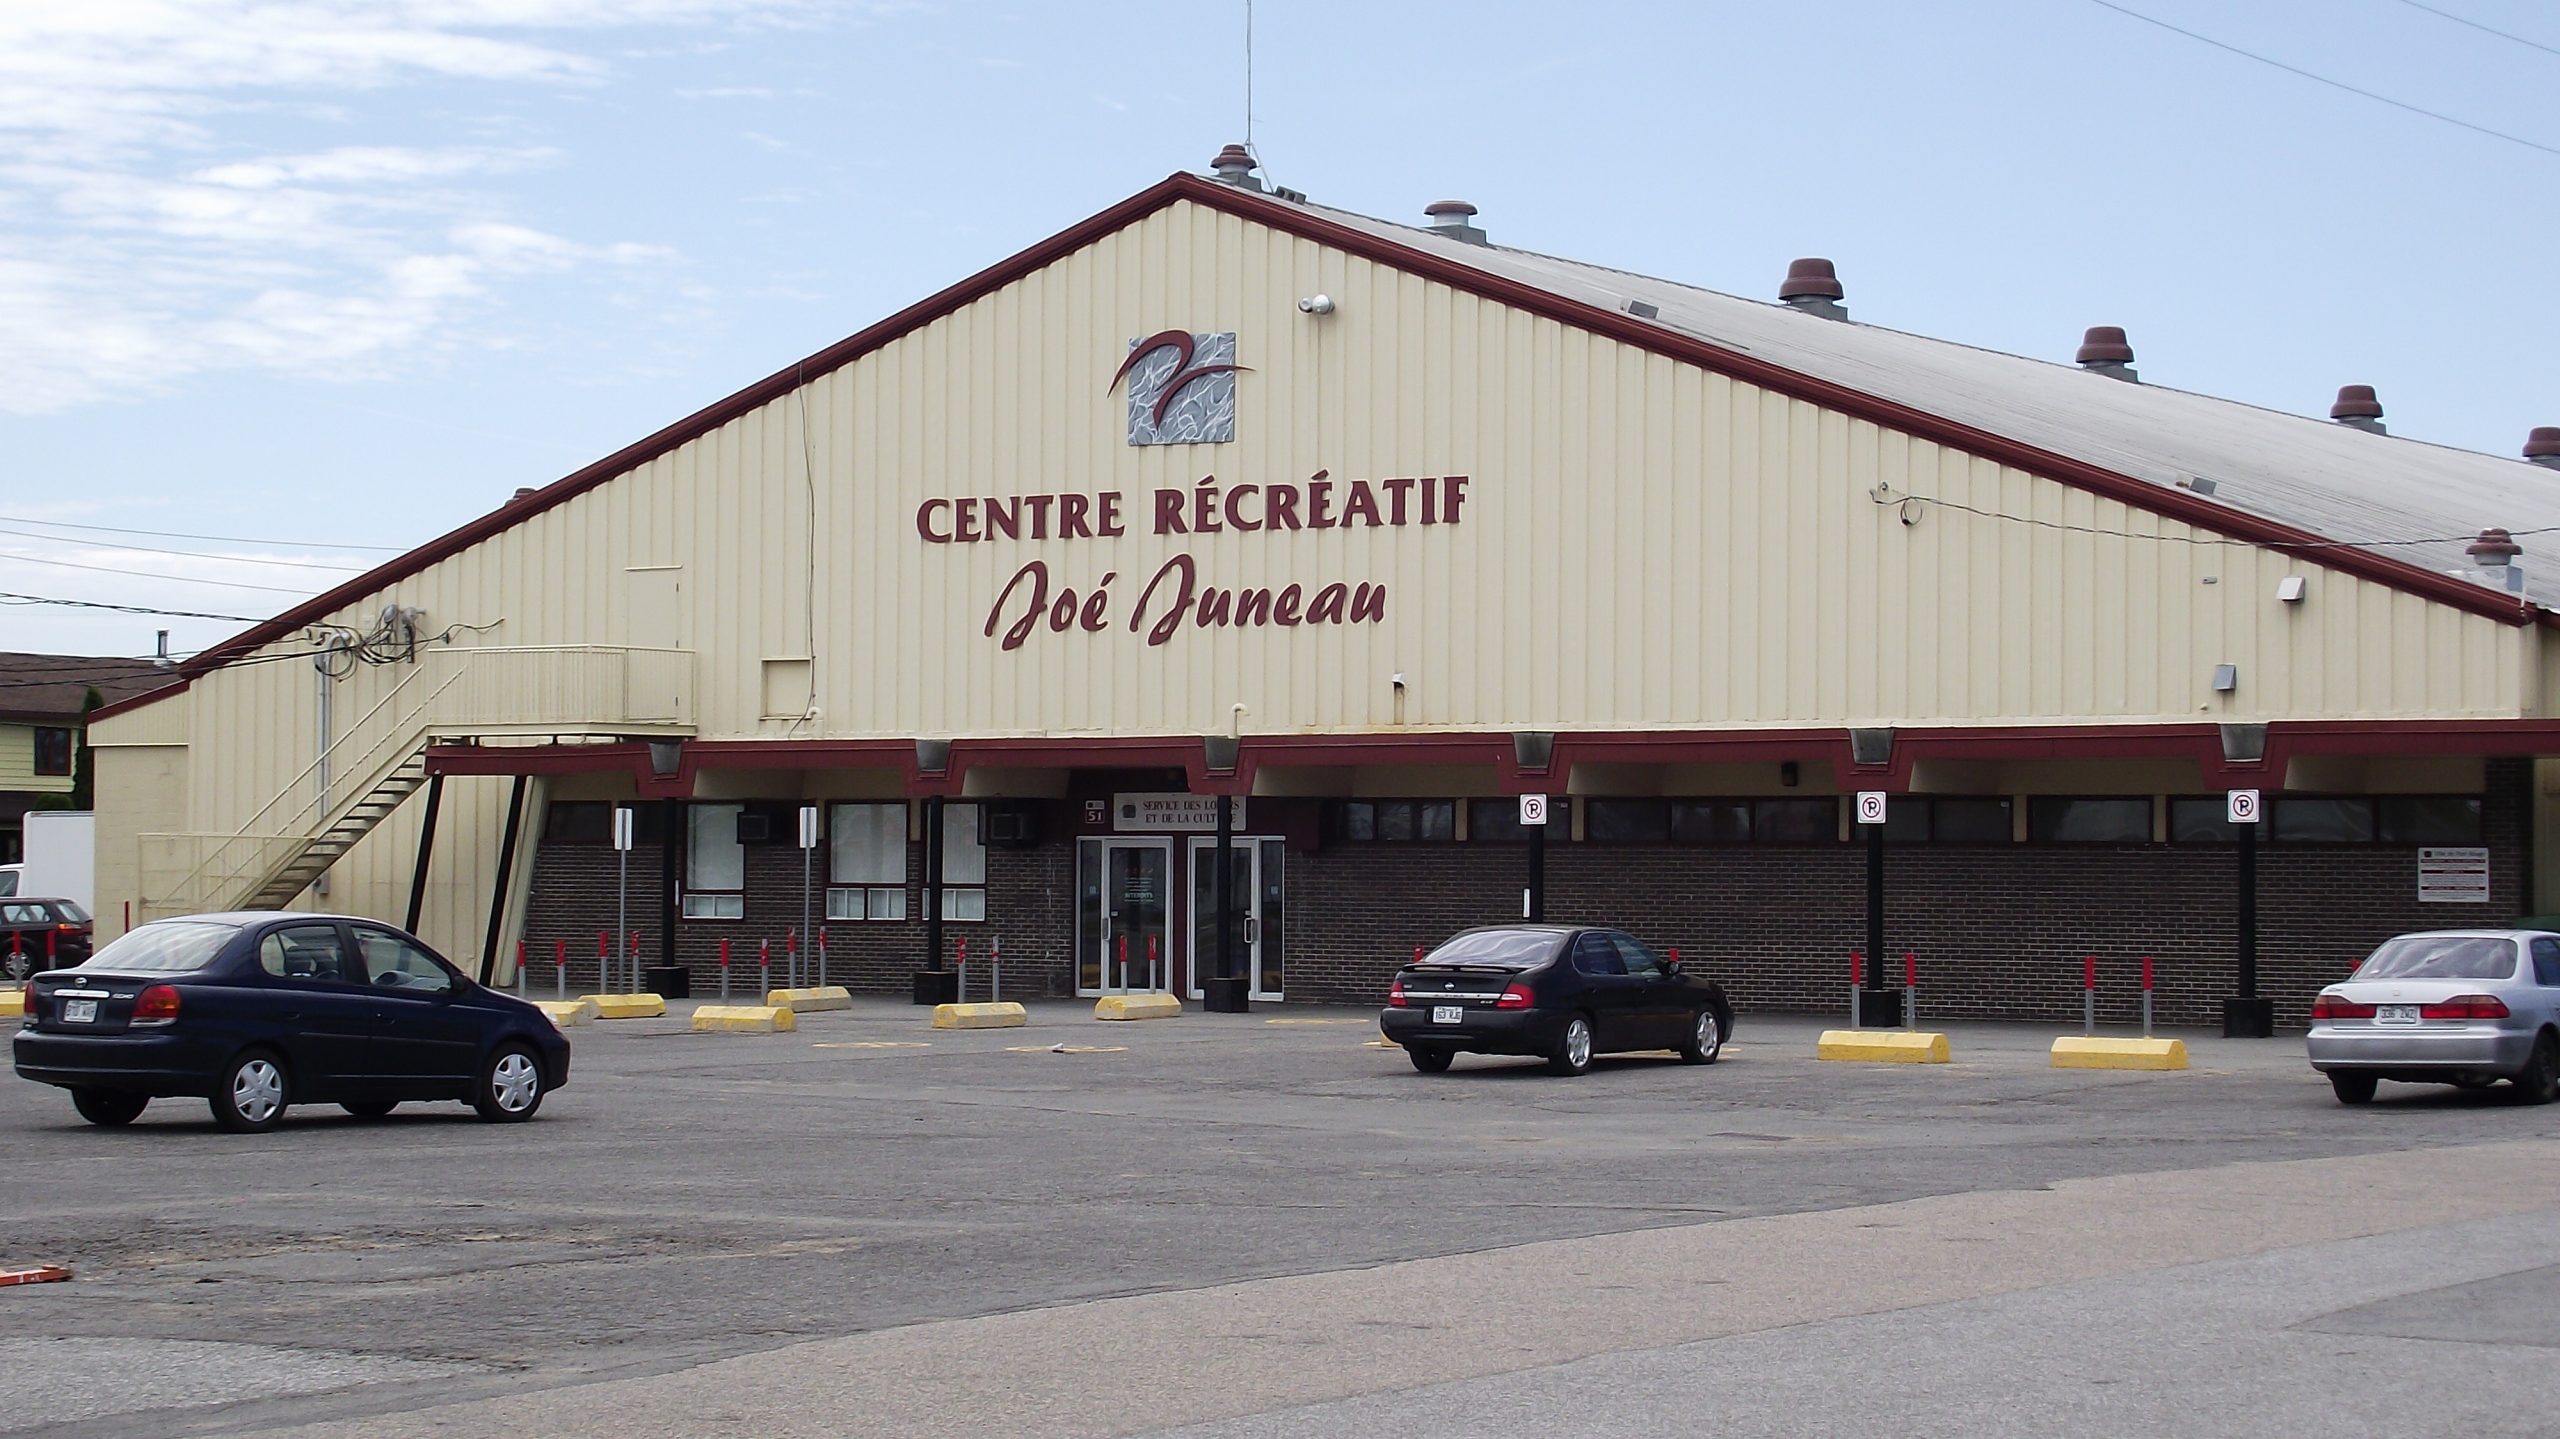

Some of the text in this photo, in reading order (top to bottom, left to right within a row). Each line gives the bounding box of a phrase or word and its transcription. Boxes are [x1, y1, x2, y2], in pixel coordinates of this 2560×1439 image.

[916, 469, 1470, 544] CENTRE RÉCRÉATIF
[984, 553, 1388, 651] Joé Juneau
[1143, 800, 1179, 811] SERVICE
[1183, 800, 1201, 810] DES
[1088, 810, 1102, 822] 51
[1145, 813, 1157, 823] ET
[1161, 813, 1174, 823] DE
[1177, 813, 1190, 823] LA
